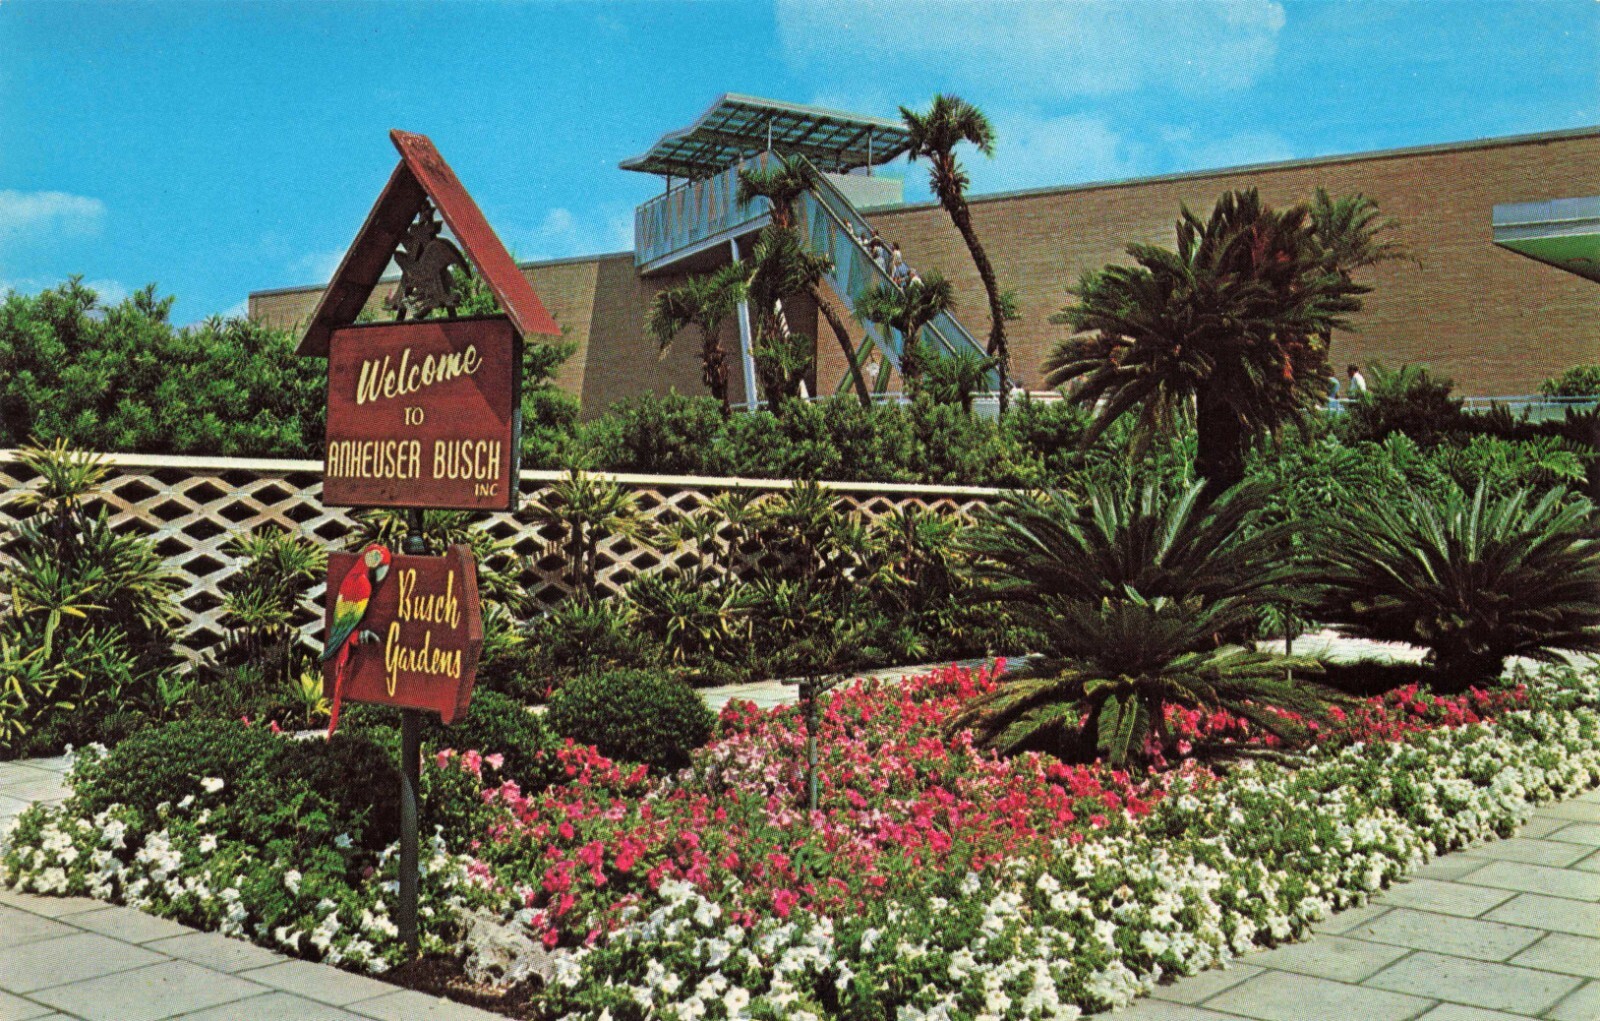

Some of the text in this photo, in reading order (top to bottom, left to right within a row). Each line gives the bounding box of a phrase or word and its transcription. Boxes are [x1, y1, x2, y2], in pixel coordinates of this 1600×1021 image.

[356, 344, 483, 405] Welcome
[403, 407, 425, 425] TO
[327, 439, 501, 480] ANHEUSER BUSCH
[474, 483, 498, 496] INC
[398, 568, 461, 629] Busch
[385, 621, 461, 697] Gardens
